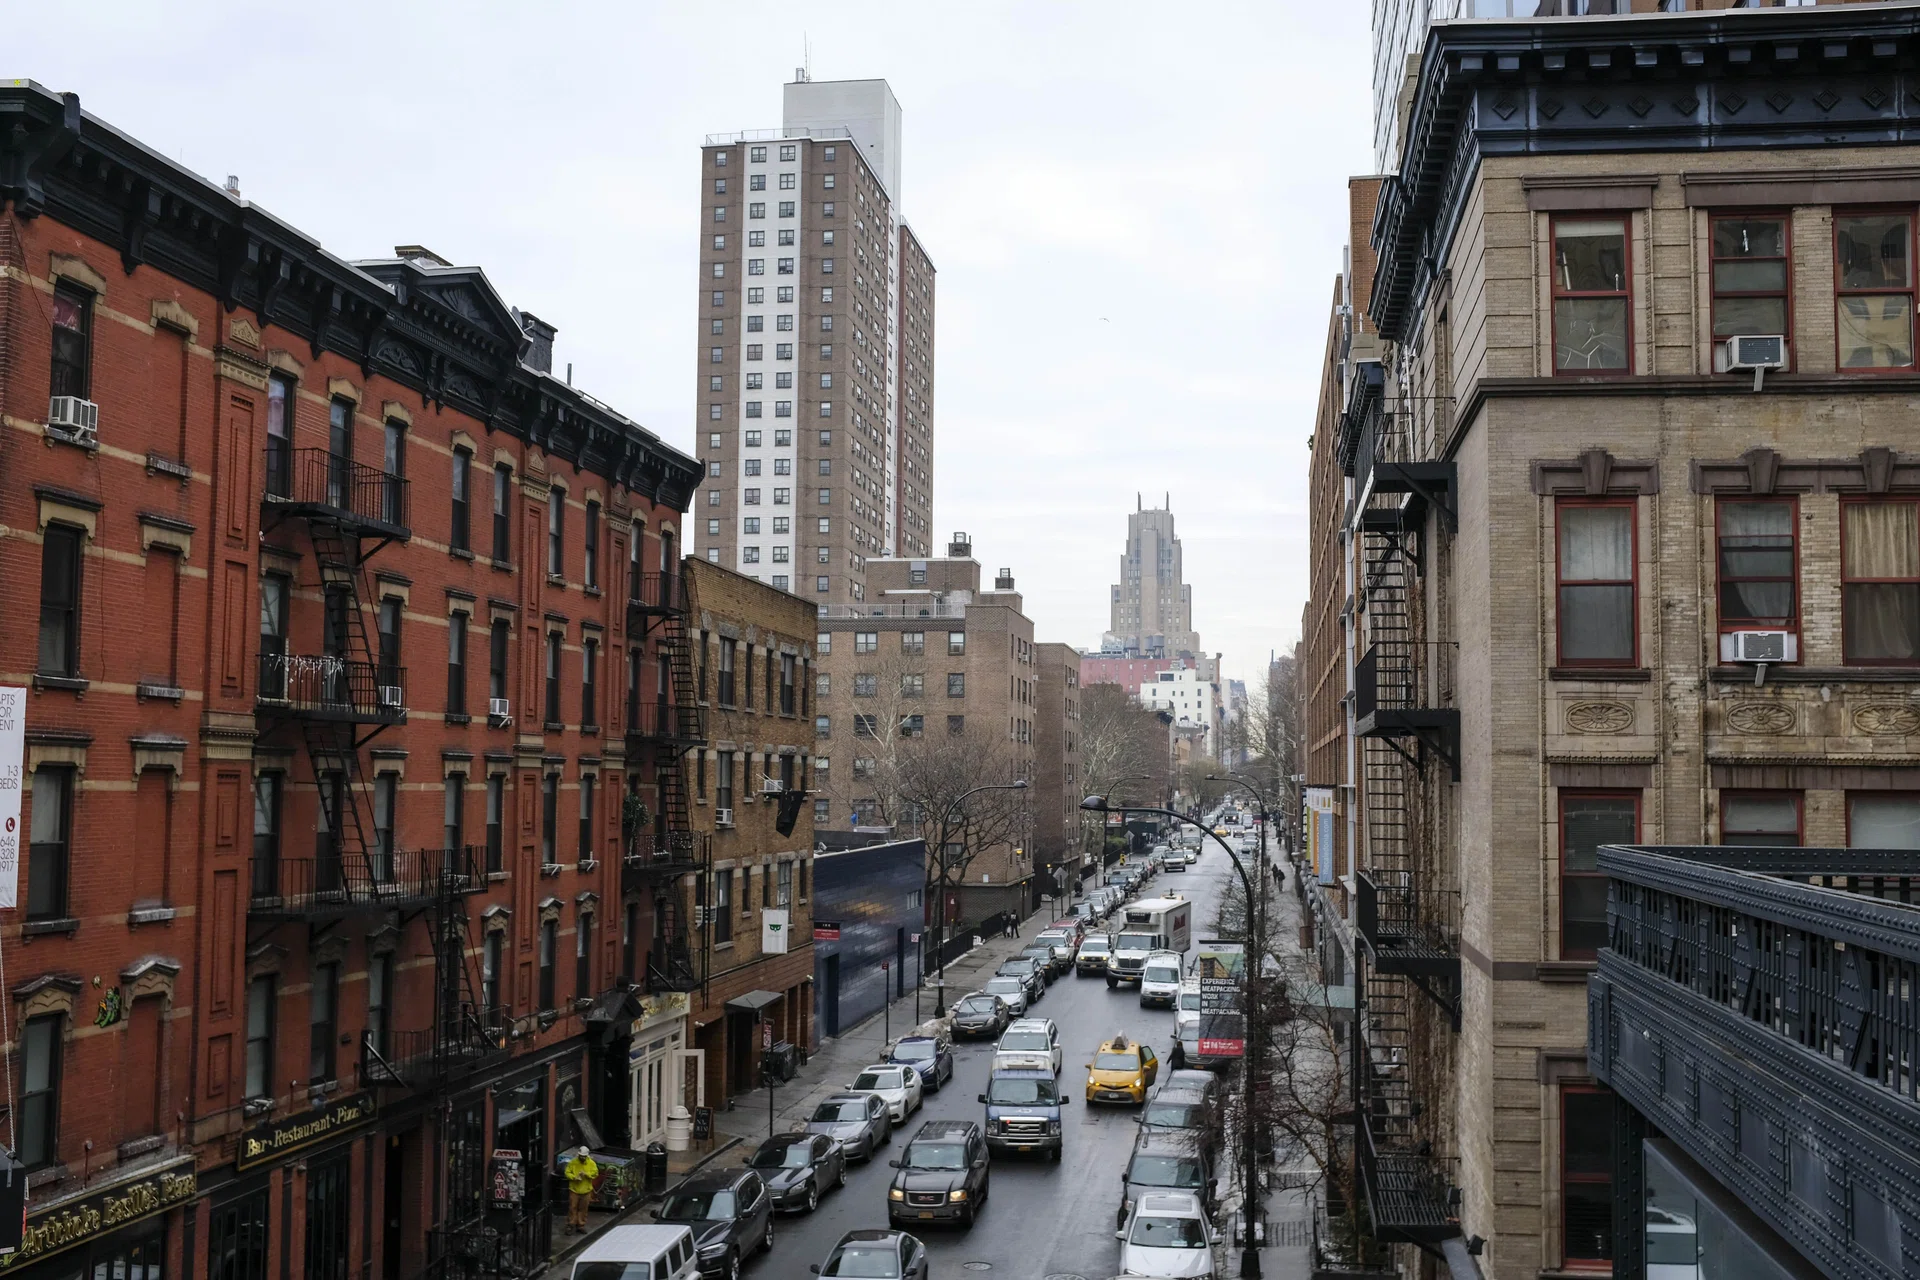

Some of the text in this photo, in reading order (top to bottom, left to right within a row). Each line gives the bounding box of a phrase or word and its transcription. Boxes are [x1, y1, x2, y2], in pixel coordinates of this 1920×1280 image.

[0, 693, 15, 705] PTS
[0, 706, 12, 717] OR
[0, 719, 14, 730] ENT
[7, 765, 19, 776] 1-3
[0, 836, 15, 847] 646
[0, 848, 15, 859] 328
[245, 1138, 268, 1158] Bar
[274, 1114, 331, 1148] Restaurant
[22, 1204, 101, 1258] Artichoke
